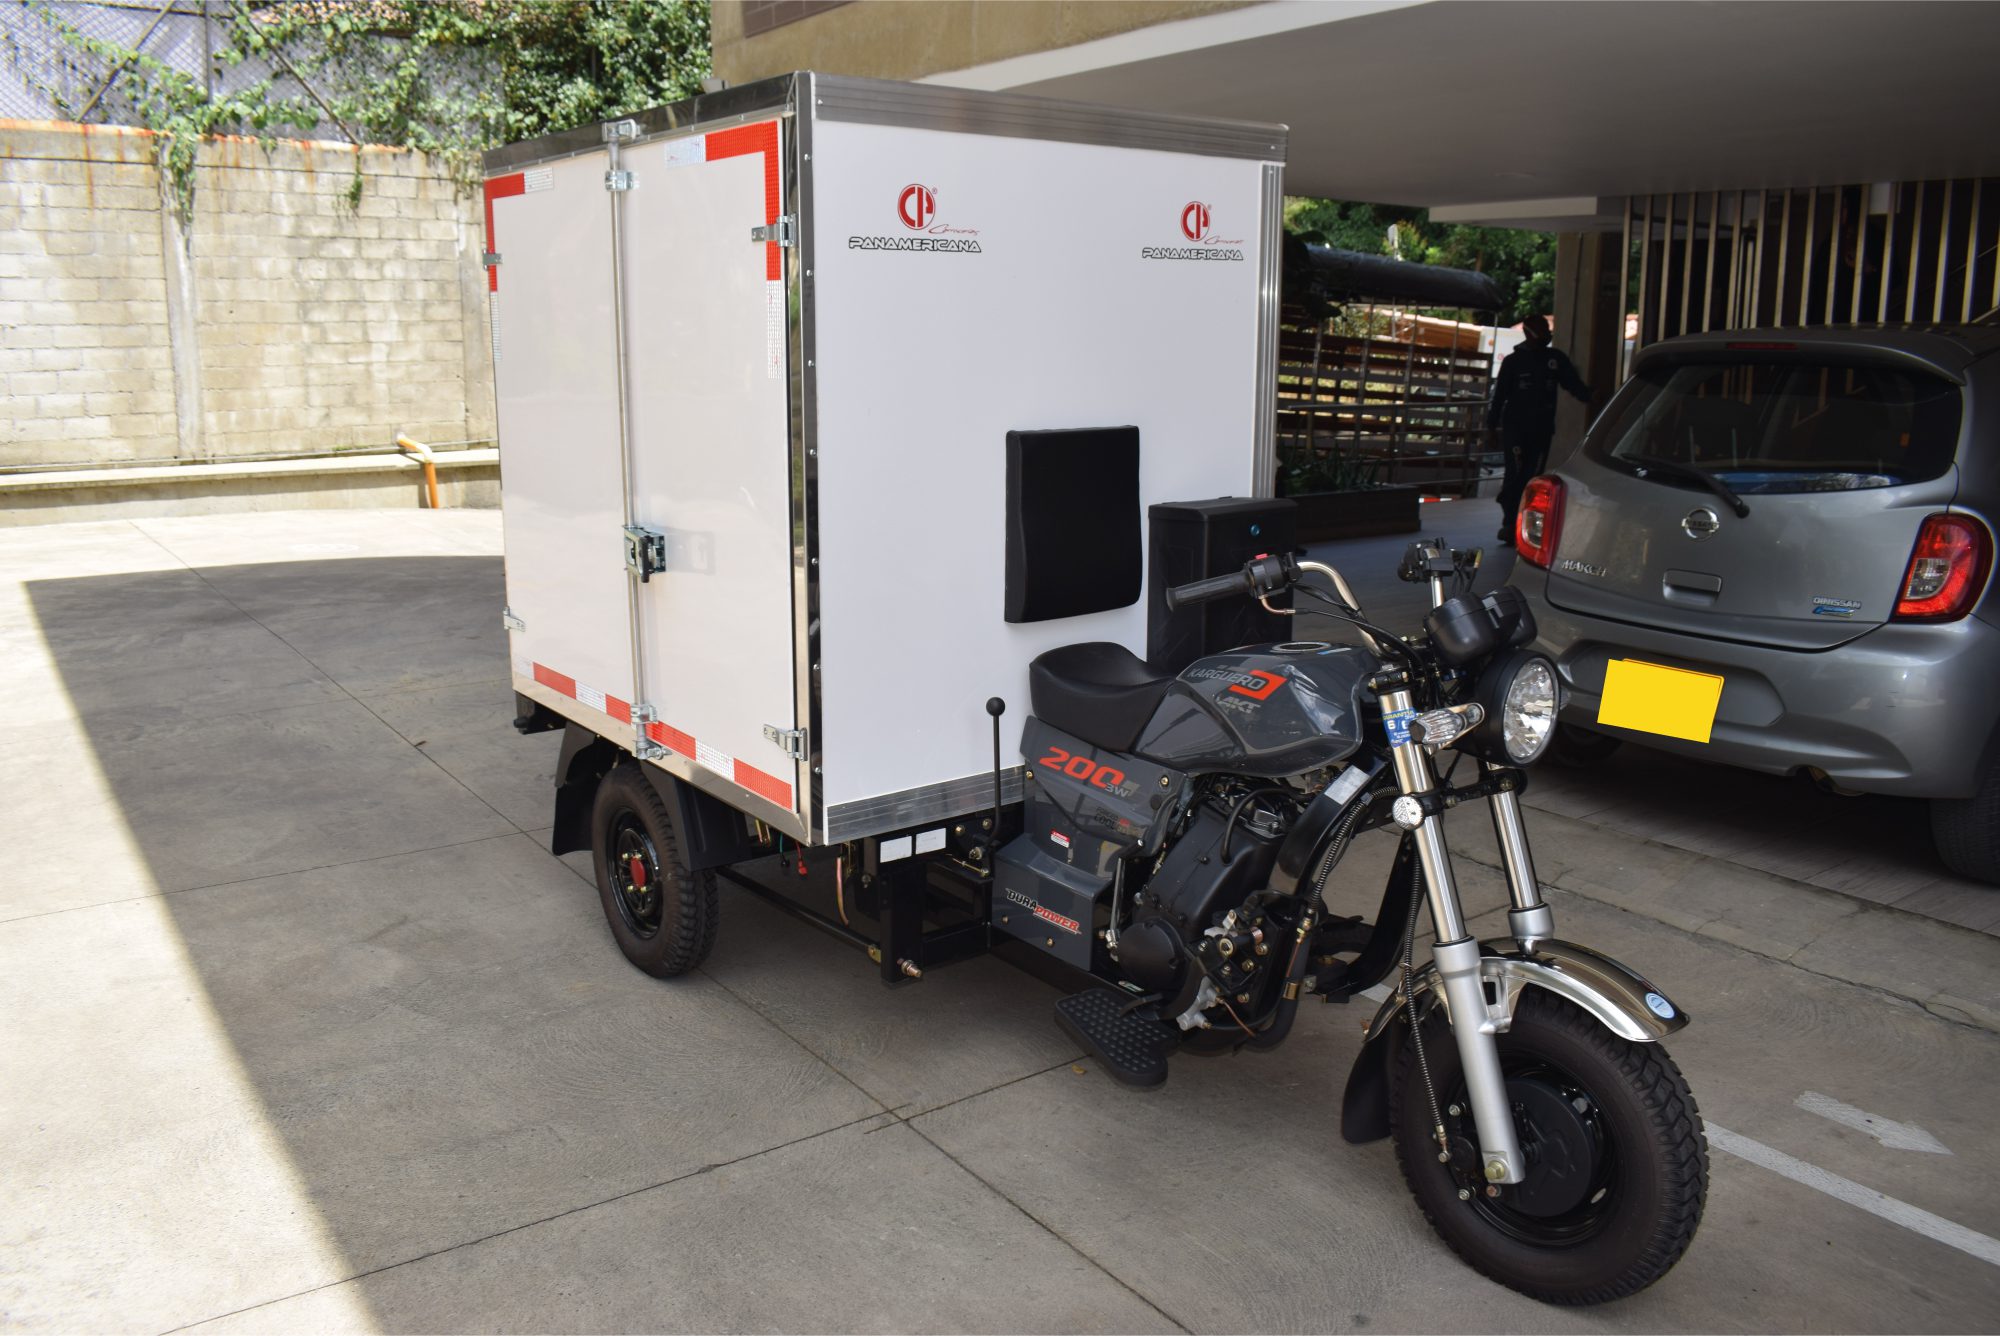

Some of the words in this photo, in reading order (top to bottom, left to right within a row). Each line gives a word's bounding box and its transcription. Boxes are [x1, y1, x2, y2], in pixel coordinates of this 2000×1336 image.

[849, 237, 981, 253] PANAMERICANA
[1142, 248, 1243, 260] PANAMERICANA
[1188, 668, 1267, 690] KARGUERO
[1039, 746, 1125, 788] 200
[1105, 782, 1129, 798] 3W
